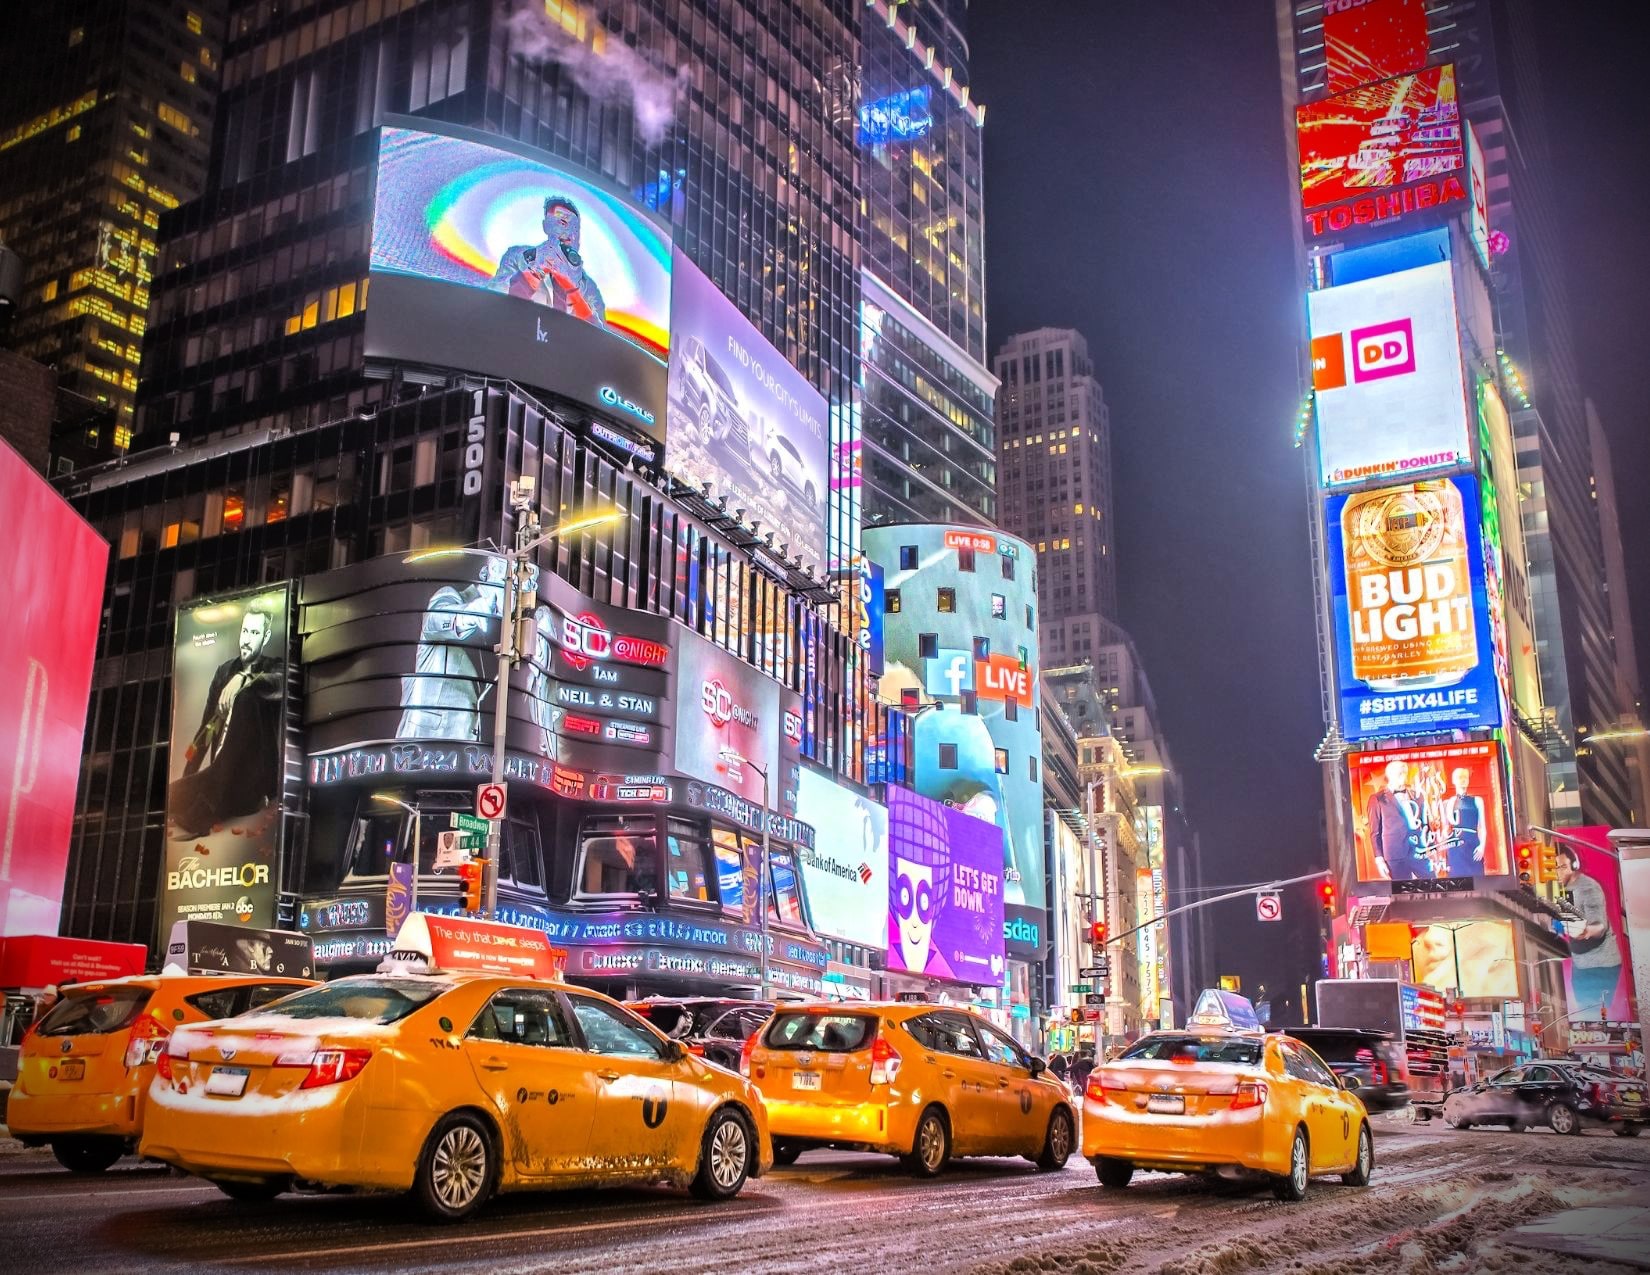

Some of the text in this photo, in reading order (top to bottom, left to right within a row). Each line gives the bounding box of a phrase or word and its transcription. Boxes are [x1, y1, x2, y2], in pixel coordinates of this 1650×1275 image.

[1306, 177, 1466, 236] TOSHIBA
[1363, 341, 1403, 364] DD
[728, 336, 749, 367] FIND
[749, 358, 775, 393] YOUR
[775, 383, 799, 416] CITY'S
[617, 395, 655, 424] LEXUS
[463, 390, 486, 495] 1500
[1344, 452, 1454, 479] DUNKIN' DONUTS
[949, 535, 971, 547] LIVE
[1361, 566, 1456, 609] BUD
[1354, 597, 1471, 644] LIGHT
[563, 618, 669, 663] SC @NIGHT
[1403, 641, 1433, 649] USING
[944, 656, 967, 696] f
[985, 665, 1028, 696] LIVE
[559, 687, 652, 713] NEIL & STAN
[702, 680, 731, 722] SC
[1360, 688, 1478, 714] #SBTIX4LIFE
[565, 715, 600, 734] ESPN
[1413, 770, 1447, 799] KISS
[459, 816, 488, 834] Broadway
[470, 837, 480, 847] 44
[167, 862, 269, 890] BACHELOR
[178, 856, 200, 872] The
[824, 857, 831, 873] of
[832, 858, 857, 882] America
[954, 863, 979, 889] LET'S
[981, 872, 998, 895] GET
[235, 901, 254, 915] abc
[954, 886, 984, 913] DOWN.
[433, 926, 453, 939] The
[454, 929, 471, 944] city
[473, 931, 491, 944] that
[519, 938, 546, 951] sleeps
